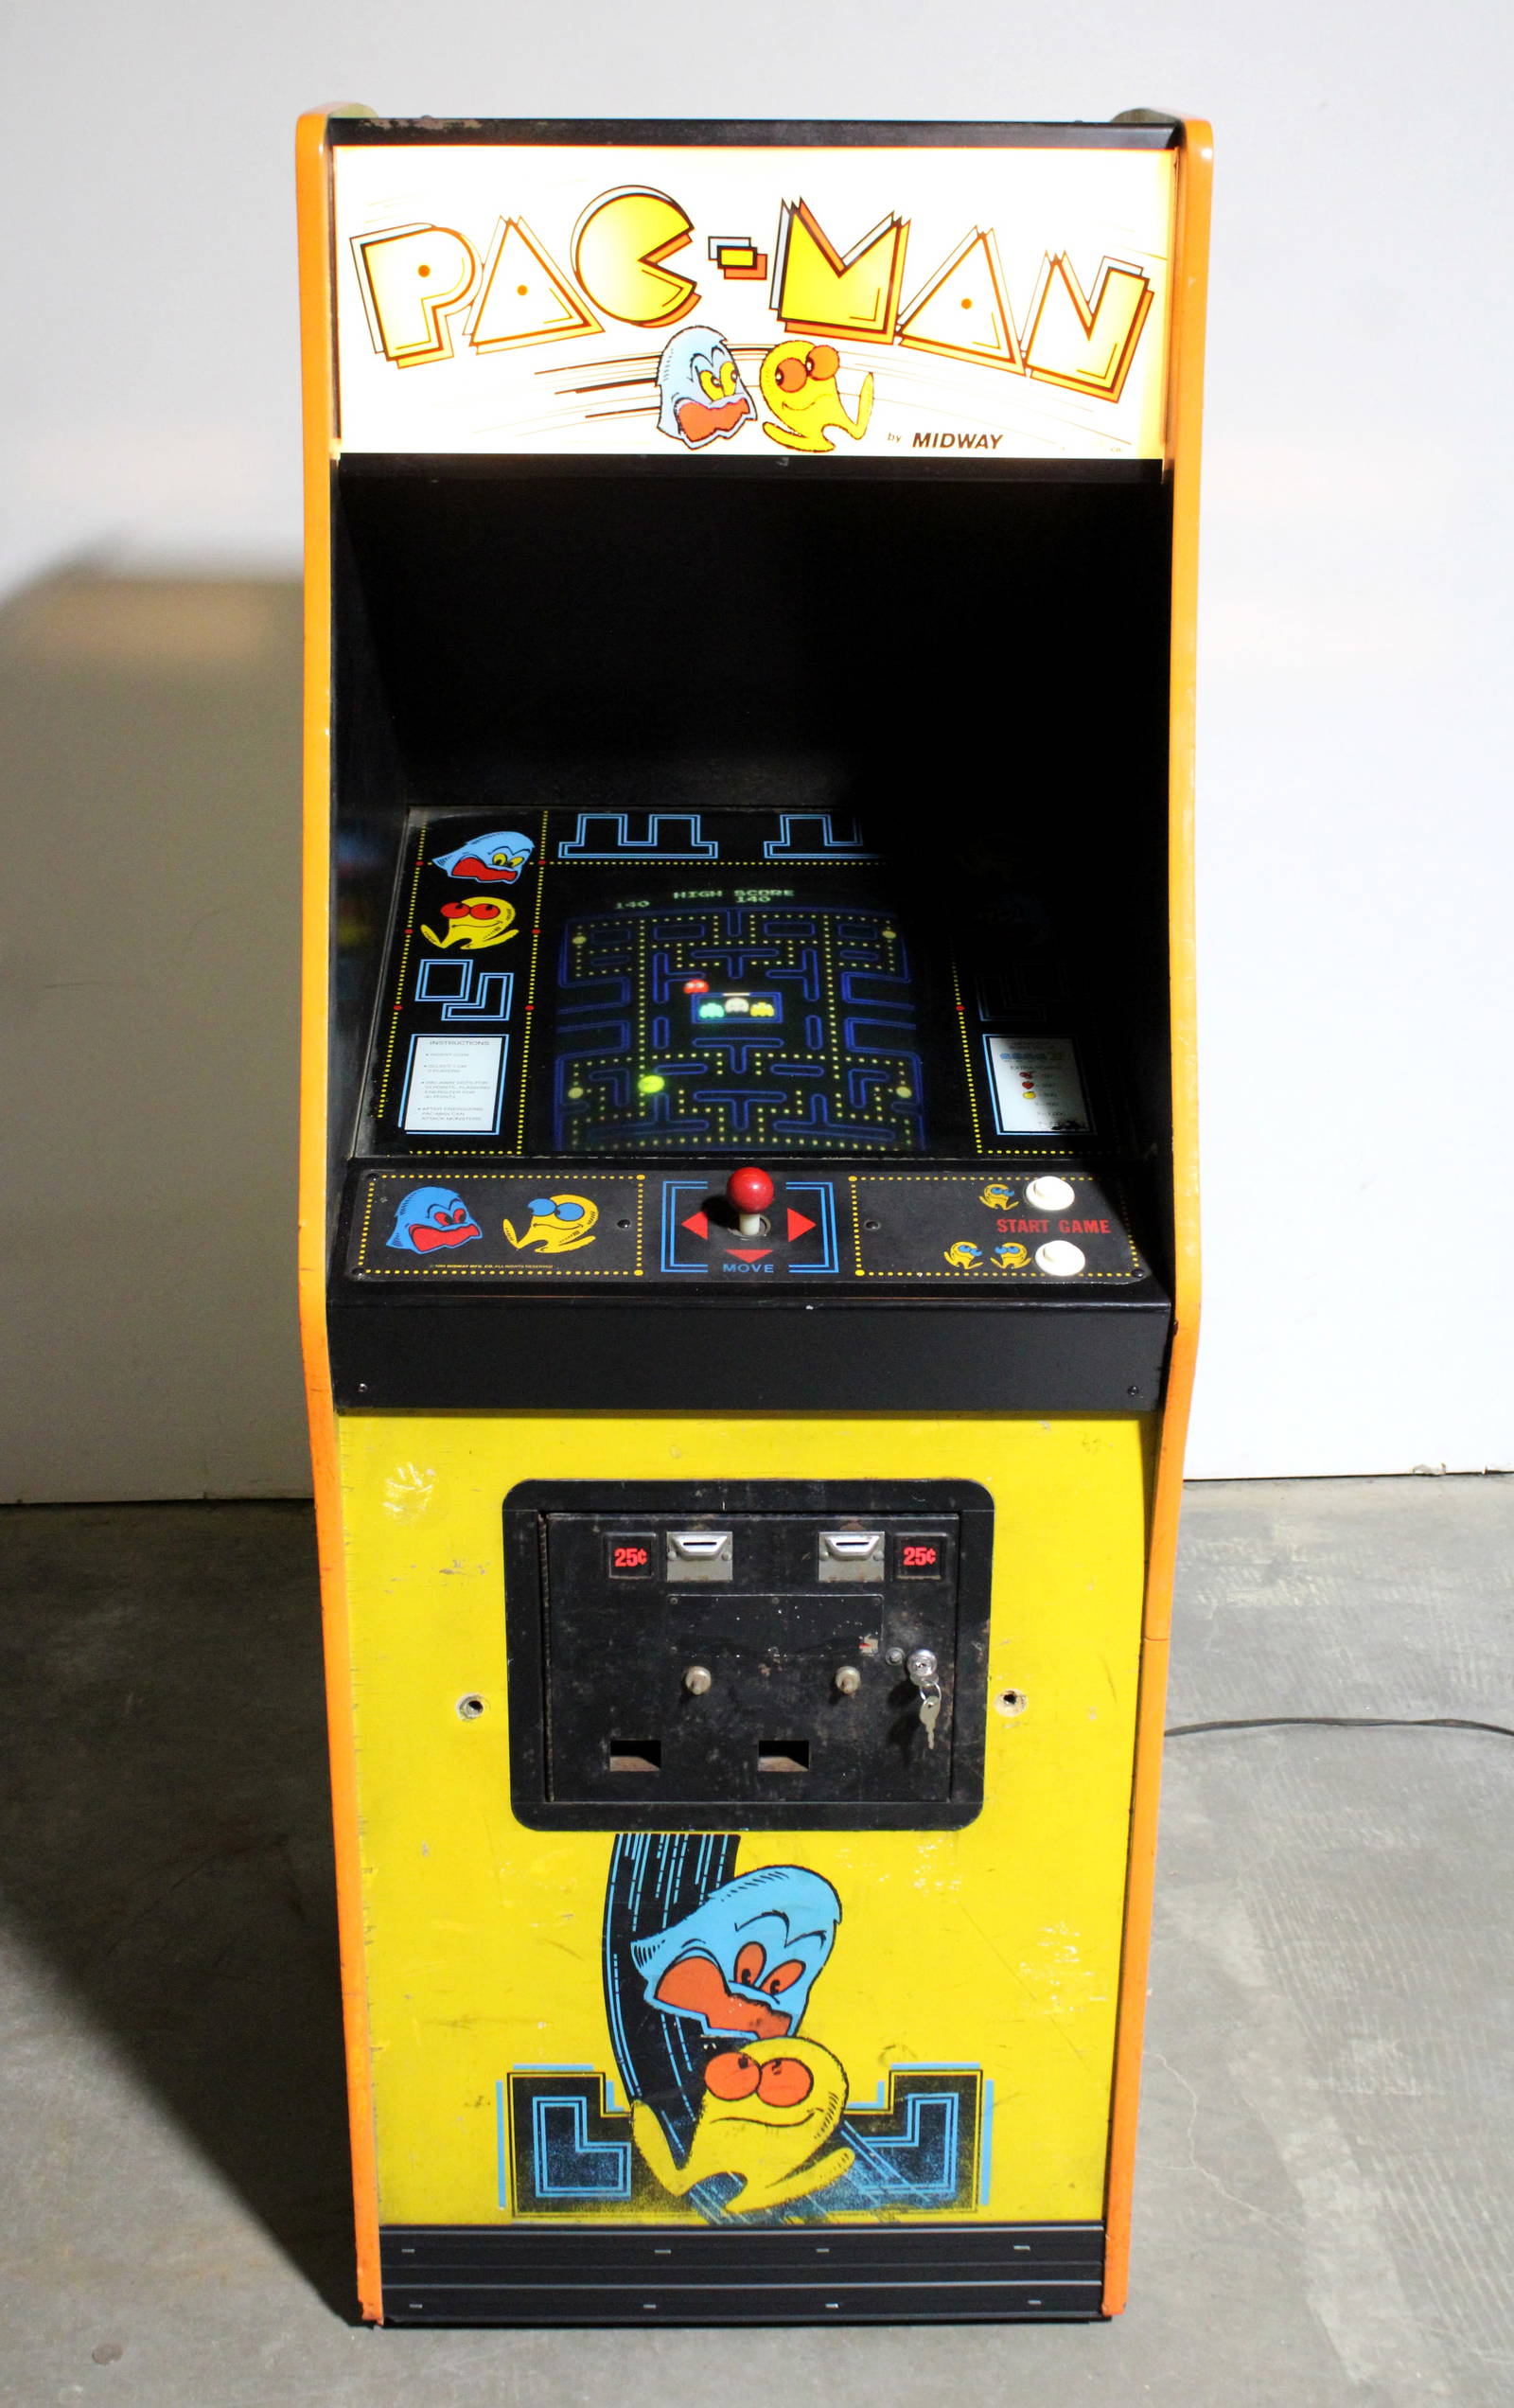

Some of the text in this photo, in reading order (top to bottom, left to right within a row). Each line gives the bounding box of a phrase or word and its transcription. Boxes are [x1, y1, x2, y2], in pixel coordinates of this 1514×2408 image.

[349, 184, 1155, 403] PAC-MAN
[887, 432, 1004, 450] by MIDWAY
[673, 889, 795, 899] HIGH SCORE
[996, 1218, 1112, 1234] START GAME
[722, 1264, 774, 1273] MOVE
[614, 1547, 648, 1567] 25¢
[903, 1546, 937, 1567] 25¢
